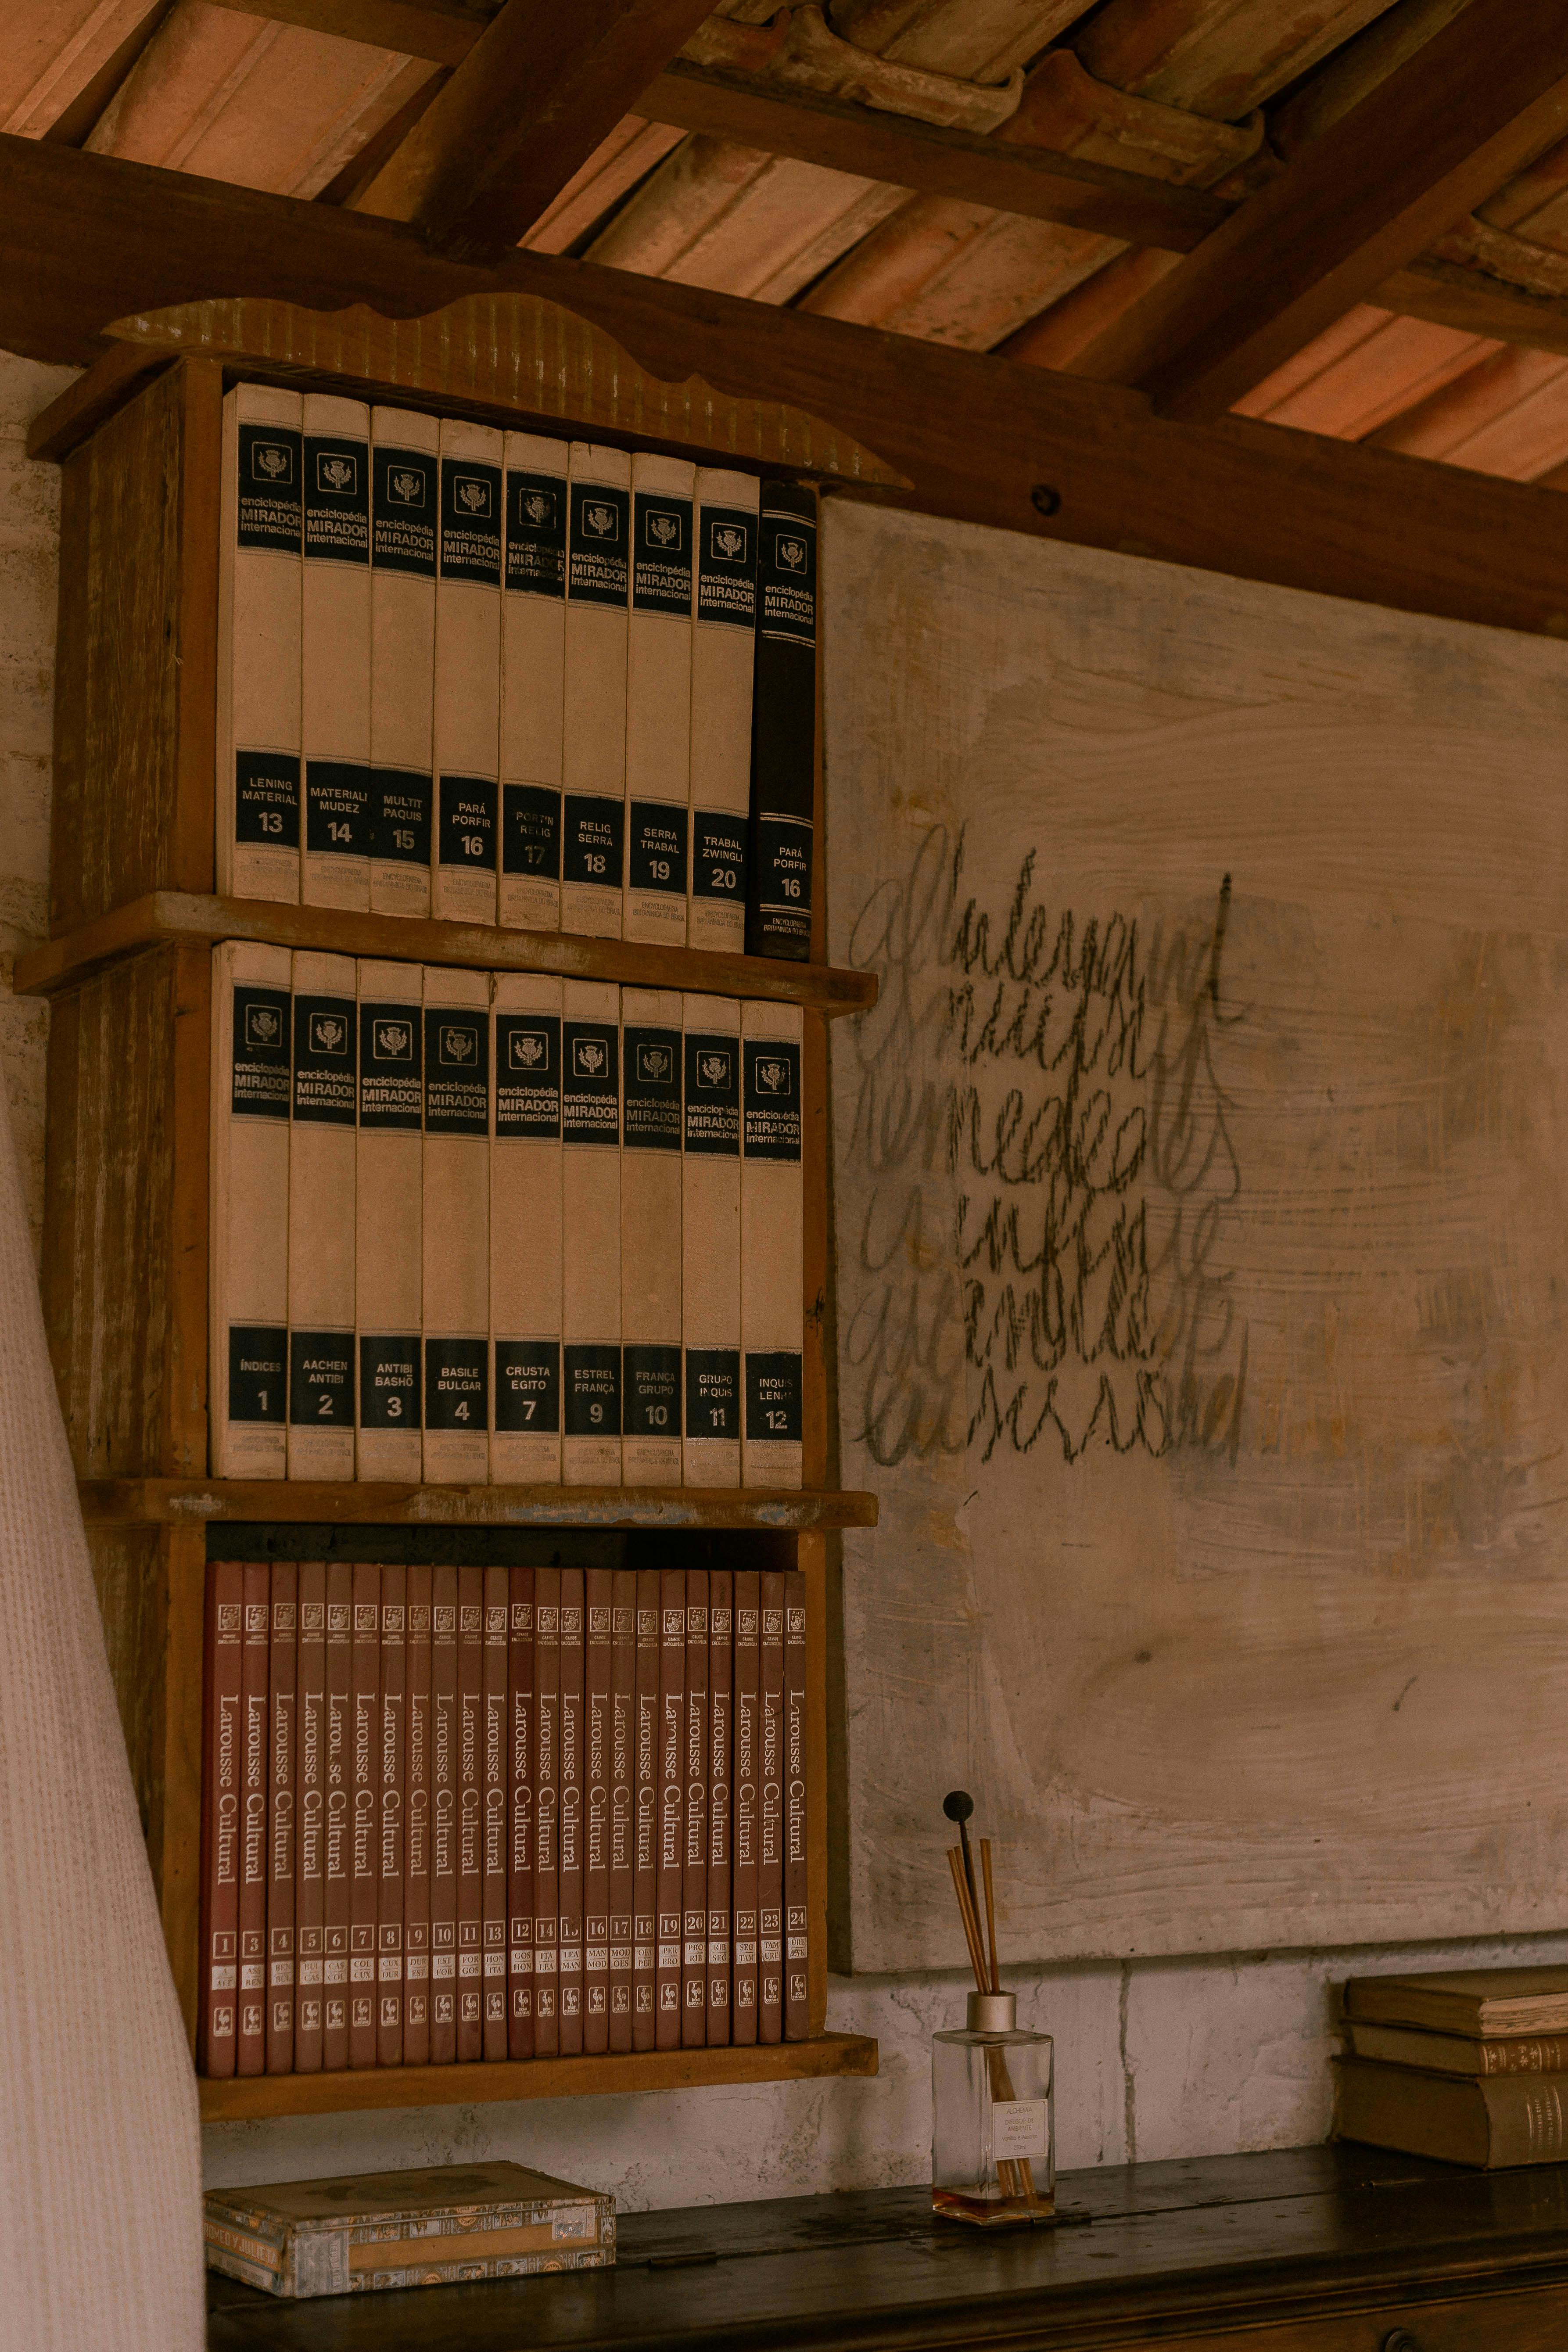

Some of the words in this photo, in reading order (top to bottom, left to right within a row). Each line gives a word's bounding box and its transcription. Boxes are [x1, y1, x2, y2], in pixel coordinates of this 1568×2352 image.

[241, 496, 301, 512] enciclopédia
[241, 509, 301, 526] MIRADOR
[308, 509, 367, 524] enciclopédia
[308, 521, 367, 538] MIRADOR
[376, 519, 434, 537] enciclopédia
[308, 532, 367, 549] internacional
[376, 531, 434, 550] MIRADOR
[444, 530, 499, 546] enciclopédia
[376, 543, 434, 561] internacional
[444, 541, 499, 560] MIRADOR
[444, 553, 499, 569] internacional
[572, 552, 627, 569] enciclopédia
[572, 564, 627, 582] MIRADOR
[636, 561, 690, 578] enciclopédia
[571, 576, 627, 592] internacional
[636, 573, 690, 591] MIRADOR
[701, 574, 754, 590] enciclopédia
[636, 584, 690, 601] internacional
[701, 585, 754, 603] MIRADOR
[765, 585, 813, 602] enciclopédia
[700, 597, 754, 613] internacional
[765, 596, 813, 614] MIRADOR
[765, 607, 813, 625] internacional
[250, 778, 292, 790] LENING
[243, 791, 298, 805] MATERIAL
[311, 787, 367, 802] MATERIALI
[320, 801, 359, 813] MUDEZ
[384, 796, 422, 809] MULTIT
[459, 803, 485, 815] PARÁ
[258, 812, 283, 833] 13
[384, 808, 422, 822] PAQUIS
[452, 815, 491, 828] PORFIR
[327, 822, 352, 842] 14
[520, 825, 550, 837] RELIG
[580, 821, 611, 833] RELIG
[644, 828, 678, 840] SERRA
[393, 829, 415, 849] 15
[461, 836, 484, 856] 16
[578, 833, 613, 846] SERRA
[704, 836, 741, 850] TRABAL
[525, 845, 545, 864] 17
[641, 840, 680, 854] TRABAL
[779, 847, 803, 858] PARÁ
[584, 853, 606, 873] 18
[703, 849, 743, 862] ZWINGLI
[649, 861, 670, 880] 19
[774, 859, 807, 871] PORFIR
[711, 869, 736, 889] 20
[782, 879, 801, 898] 16
[235, 1075, 290, 1090] MIRADOR
[297, 1070, 355, 1084] enciclopédia
[362, 1077, 421, 1088] enciclopédia
[297, 1082, 355, 1098] MIRADOR
[428, 1082, 486, 1094] enciclopédia
[499, 1087, 558, 1097] enciclopédia
[297, 1095, 355, 1109] internacional
[362, 1089, 421, 1103] MIRADOR
[428, 1094, 486, 1108] MIRADOR
[564, 1093, 617, 1105] enciclopédia
[362, 1102, 421, 1114] internacional
[499, 1100, 558, 1112] MIRADOR
[627, 1098, 680, 1110] enciclopédia
[428, 1107, 486, 1119] internacional
[499, 1112, 558, 1122] internacional
[563, 1106, 617, 1119] MIRADOR
[627, 1110, 680, 1124] MIRADOR
[563, 1118, 617, 1130] internacional
[627, 1122, 680, 1135] internacional
[688, 1116, 739, 1131] MIRADOR
[747, 1122, 800, 1135] MIRADOR
[240, 1359, 281, 1372] ÍNDICES
[303, 1361, 348, 1371] AACHEN
[377, 1364, 413, 1374] ANTIBI
[442, 1368, 478, 1377] BASILE
[506, 1367, 550, 1376] CRUSTA
[309, 1374, 344, 1384] ANTIBI
[575, 1370, 614, 1379] ESTREL
[636, 1372, 675, 1383] FRANÇA
[699, 1375, 732, 1384] GRUPO
[438, 1381, 481, 1390] BULGAR
[511, 1380, 546, 1390] EGITO
[575, 1383, 614, 1394] FRANÇA
[639, 1385, 673, 1395] GRUPO
[760, 1379, 793, 1387] INQUIS
[700, 1388, 732, 1397] INQUIS
[258, 1391, 267, 1411] 1
[318, 1395, 333, 1415] 2
[387, 1397, 402, 1417] 3
[455, 1402, 470, 1421] 4
[523, 1401, 536, 1420] 7
[590, 1404, 603, 1423] 9
[646, 1406, 667, 1425] 10
[710, 1408, 725, 1426] 11
[766, 1411, 788, 1429] 12
[220, 1695, 238, 1787] Larousse
[276, 1692, 294, 1785] Larousse
[305, 1691, 323, 1784] Larousse
[356, 1693, 375, 1783] Larousse
[437, 1693, 453, 1783] Larousse
[463, 1693, 480, 1782] Larousse
[515, 1691, 532, 1779] Larousse
[540, 1692, 556, 1780] Larousse
[689, 1690, 706, 1777] Larousse
[740, 1692, 756, 1777] Larousse
[462, 1788, 479, 1876] Cultural
[514, 1785, 531, 1873] Cultural
[538, 1787, 555, 1873] Cultural
[688, 1782, 704, 1867] Cultural
[739, 1784, 755, 1867] Cultural
[218, 1793, 237, 1885] Cultural
[275, 1790, 293, 1882] Cultural
[303, 1790, 322, 1881] Cultural
[355, 1789, 373, 1879] Cultural
[436, 1789, 453, 1878] Cultural
[516, 1924, 529, 1937] 12
[539, 1924, 553, 1937] 14
[687, 1917, 703, 1929] 20
[740, 1917, 754, 1929] 22
[279, 1934, 287, 1948] 4
[308, 1933, 316, 1947] 5
[359, 1931, 367, 1945] 7
[438, 1928, 451, 1942] 10
[463, 1927, 477, 1941] 11
[222, 1938, 229, 1952] 1
[232, 2234, 239, 2248] Y
[239, 2238, 276, 2265] JULIETA
